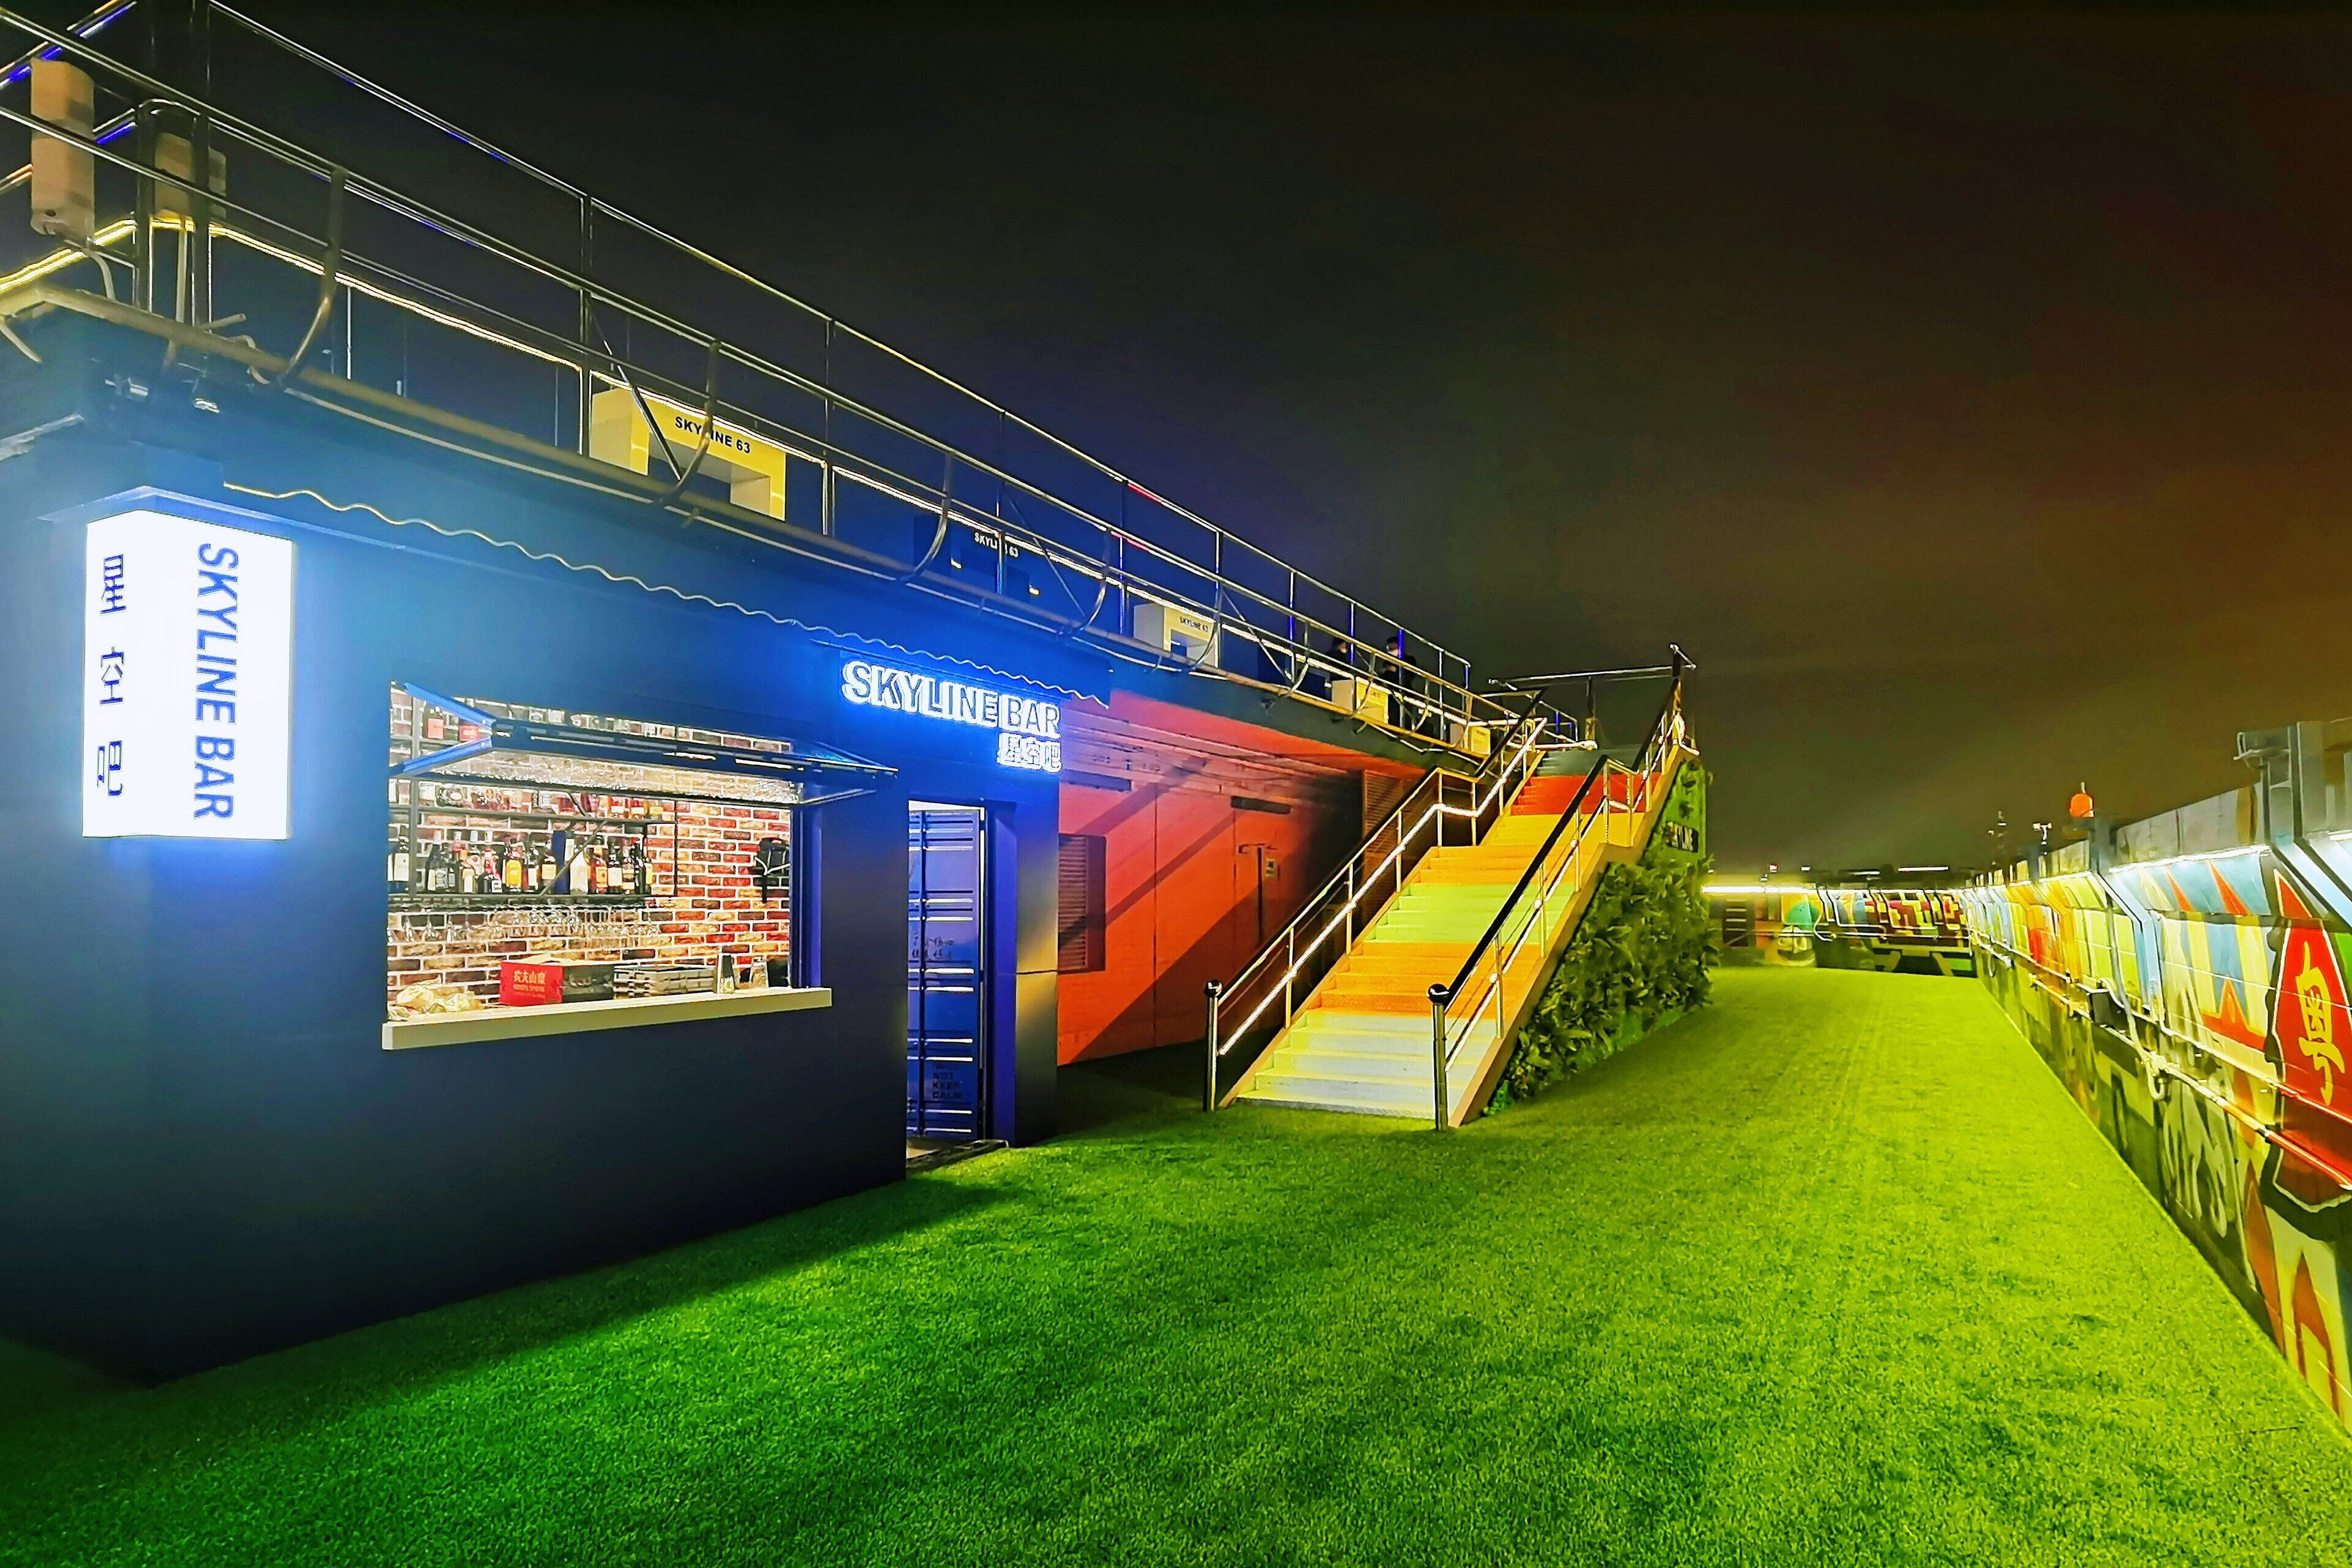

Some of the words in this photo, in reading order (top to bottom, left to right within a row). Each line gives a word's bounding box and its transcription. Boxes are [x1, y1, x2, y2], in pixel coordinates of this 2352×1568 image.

[675, 417, 732, 448] SKYINE
[736, 439, 751, 454] 63
[974, 532, 1008, 554] SKYLI
[195, 543, 239, 724] SKYLINE
[97, 554, 127, 797] 星空吧
[842, 661, 999, 728] SKYLINE
[998, 694, 1061, 739] BAR
[194, 735, 236, 820] BAR
[997, 732, 1063, 773] 星空吧
